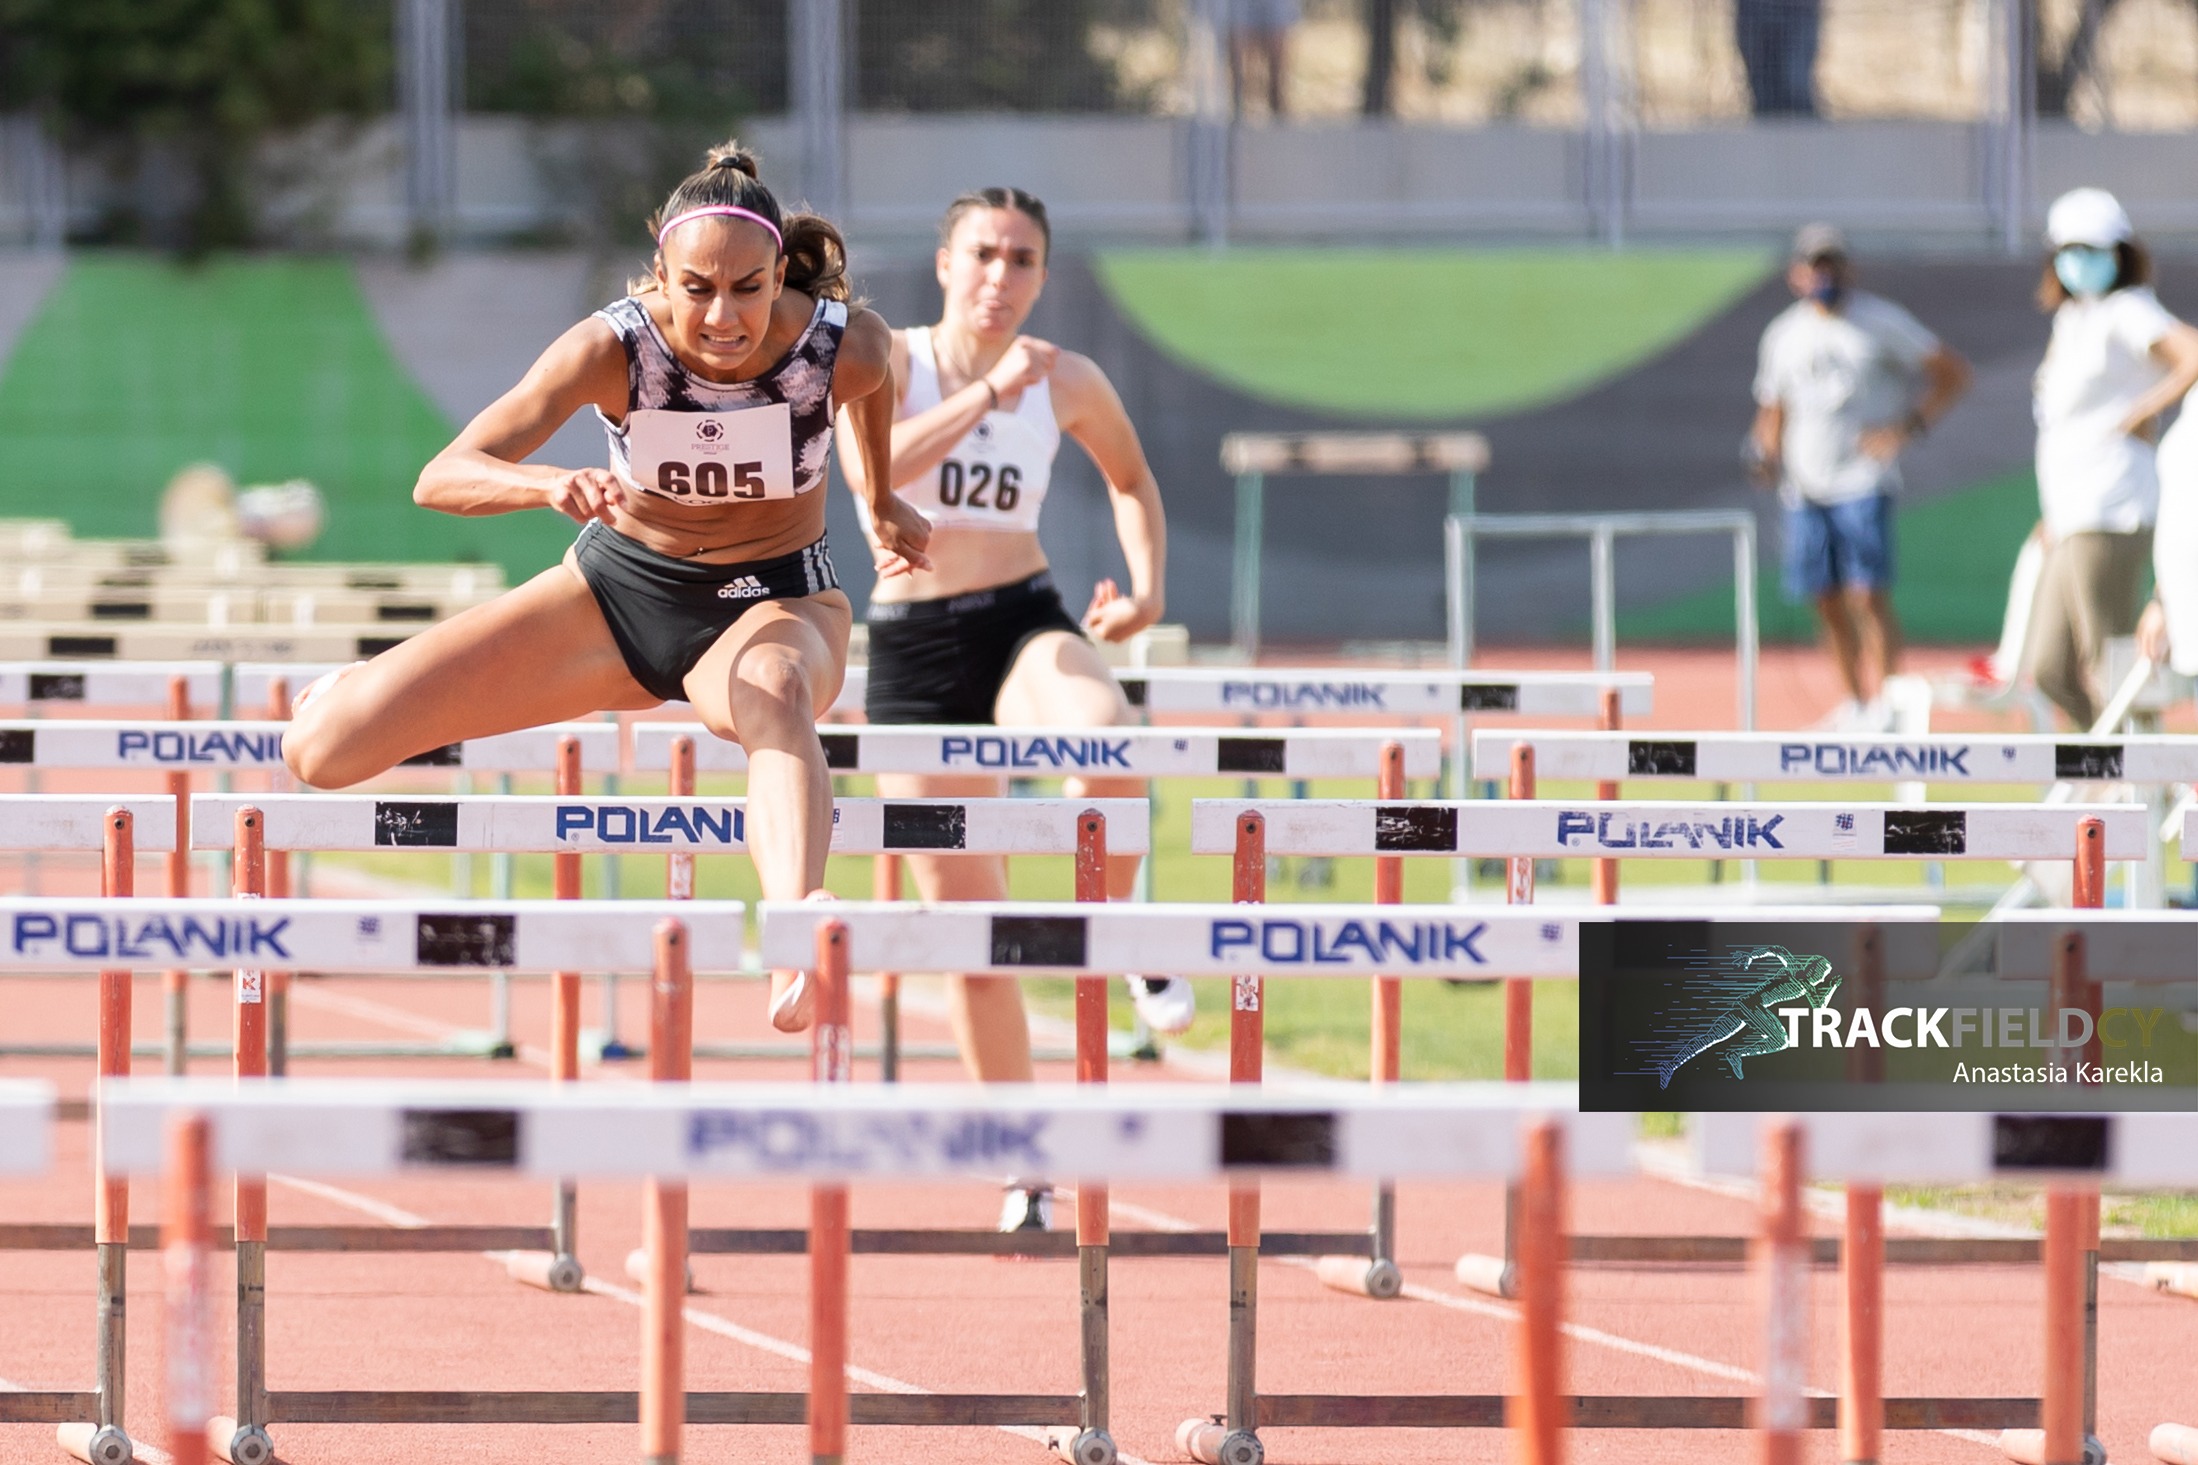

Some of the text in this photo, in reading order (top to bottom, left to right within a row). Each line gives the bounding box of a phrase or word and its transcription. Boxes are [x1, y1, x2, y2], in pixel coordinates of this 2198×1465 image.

[658, 461, 766, 499] 605
[940, 461, 1021, 511] 026
[717, 586, 771, 598] adidas
[1222, 682, 1387, 706] POLANIK
[118, 731, 283, 761] POLANI
[941, 738, 1131, 768] POLANIK
[1780, 744, 1970, 775] POLANIK
[556, 806, 744, 843] POLANI
[1558, 811, 1785, 850] POLANIK
[12, 914, 292, 958] POLANIK
[1210, 920, 1487, 963] POLANIK
